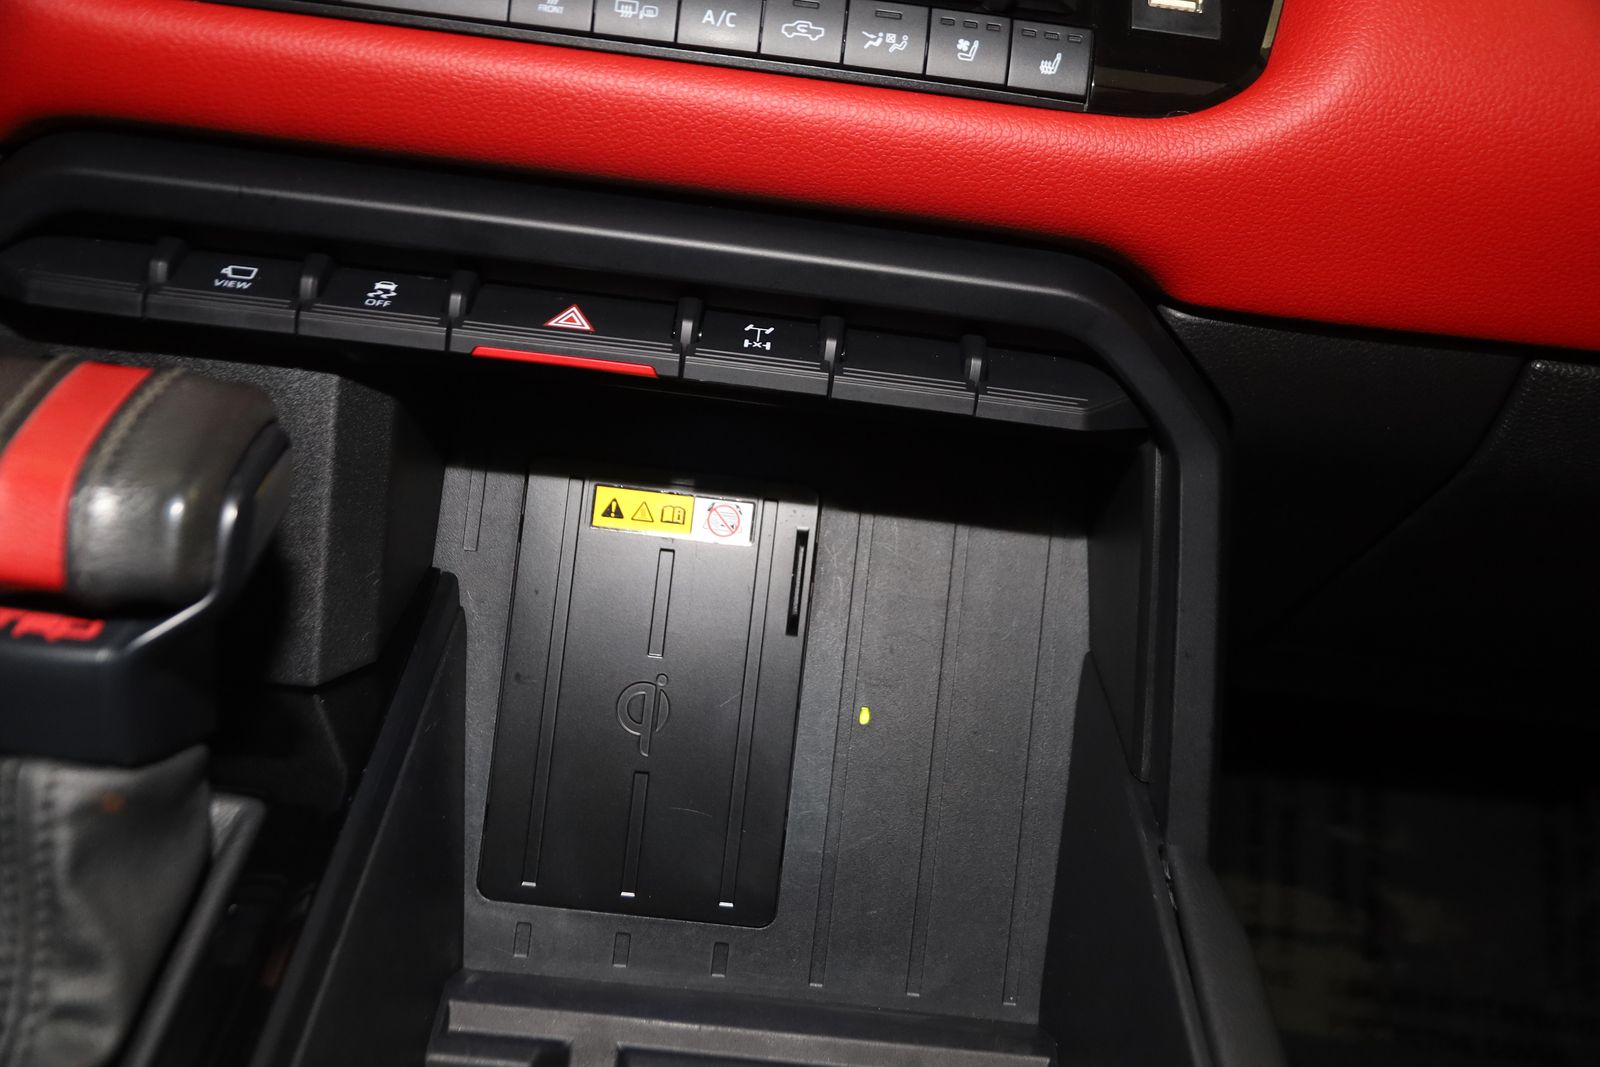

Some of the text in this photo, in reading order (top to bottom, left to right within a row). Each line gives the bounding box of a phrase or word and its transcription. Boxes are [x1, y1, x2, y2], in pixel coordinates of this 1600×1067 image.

[701, 9, 737, 28] A/C
[213, 278, 253, 290] VIEW
[363, 298, 392, 308] OFF
